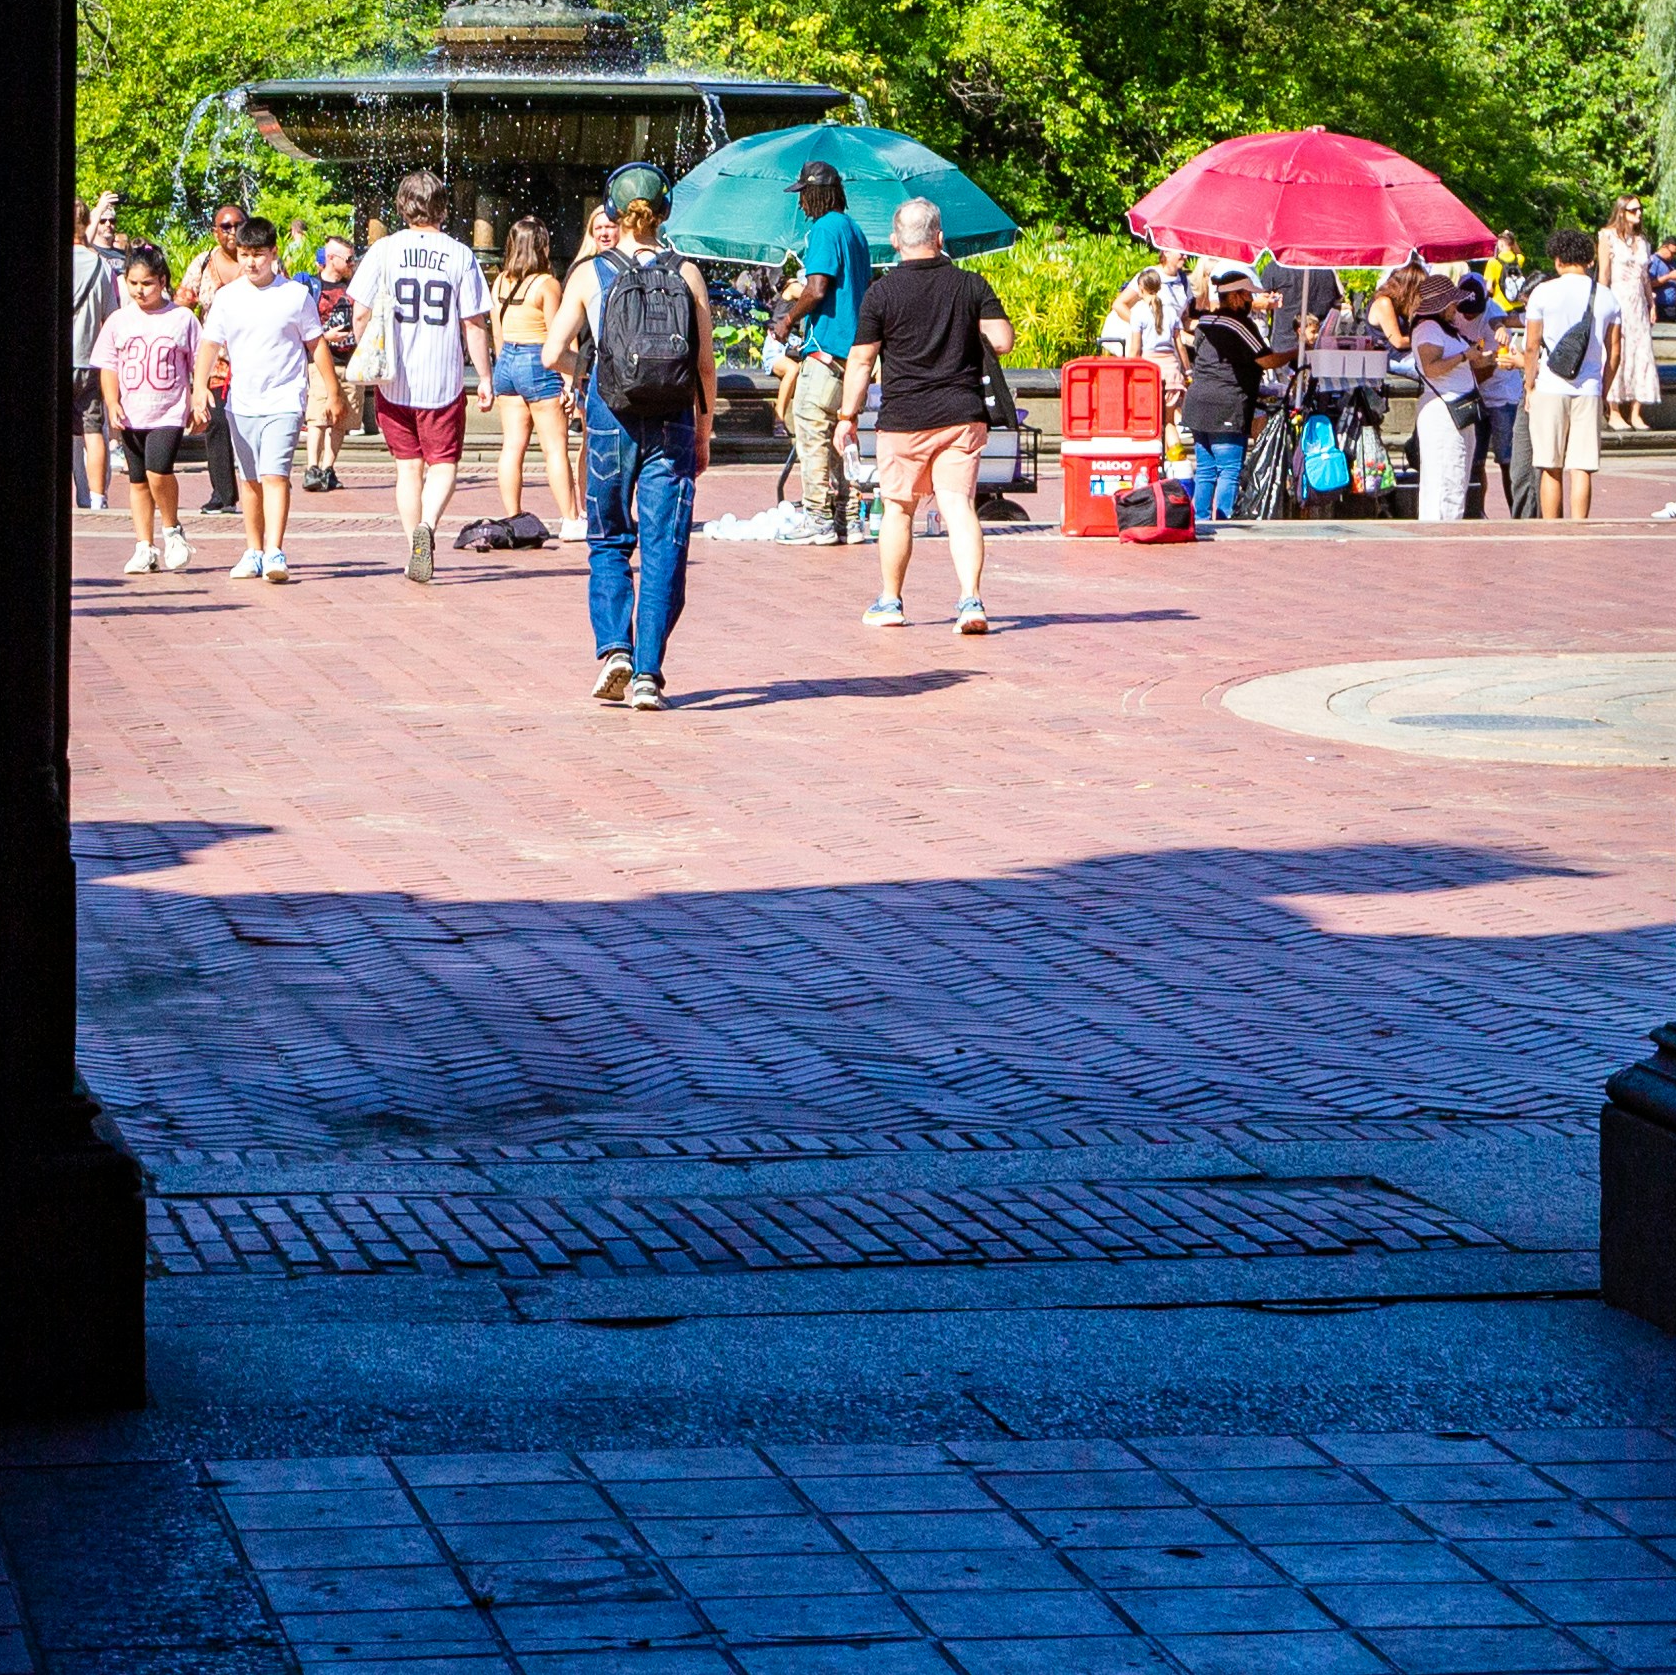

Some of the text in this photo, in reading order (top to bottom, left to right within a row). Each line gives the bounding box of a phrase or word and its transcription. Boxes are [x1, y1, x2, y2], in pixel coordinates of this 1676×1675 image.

[399, 248, 450, 272] JUDGE
[395, 277, 453, 326] 99
[121, 336, 178, 391] 80
[1091, 460, 1133, 471] IGLOO
